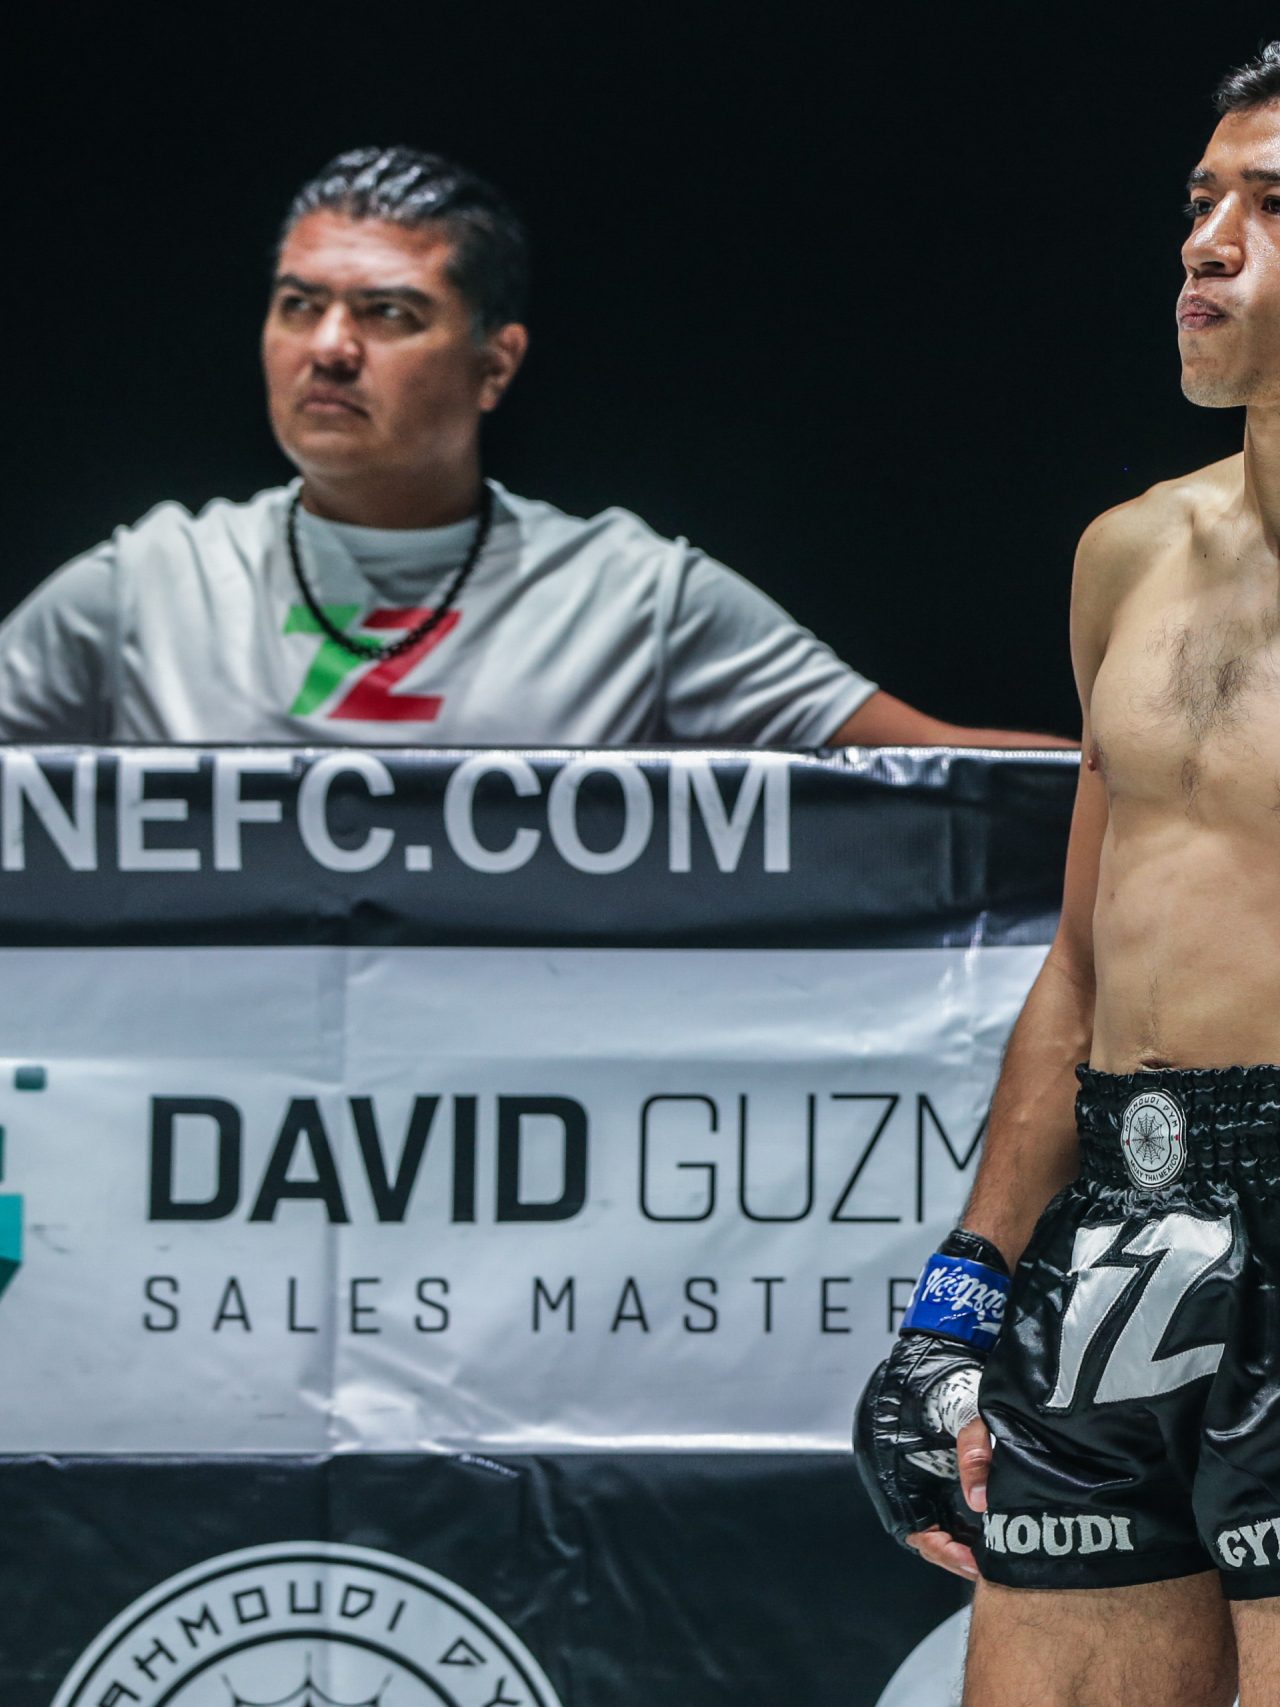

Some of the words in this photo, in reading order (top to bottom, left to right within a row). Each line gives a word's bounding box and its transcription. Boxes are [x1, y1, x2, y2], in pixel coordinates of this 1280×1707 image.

[0, 750, 792, 875] NEFC.COM
[147, 1094, 589, 1224] DAVID
[143, 1276, 450, 1333] SALES
[921, 1266, 1008, 1336] airtex
